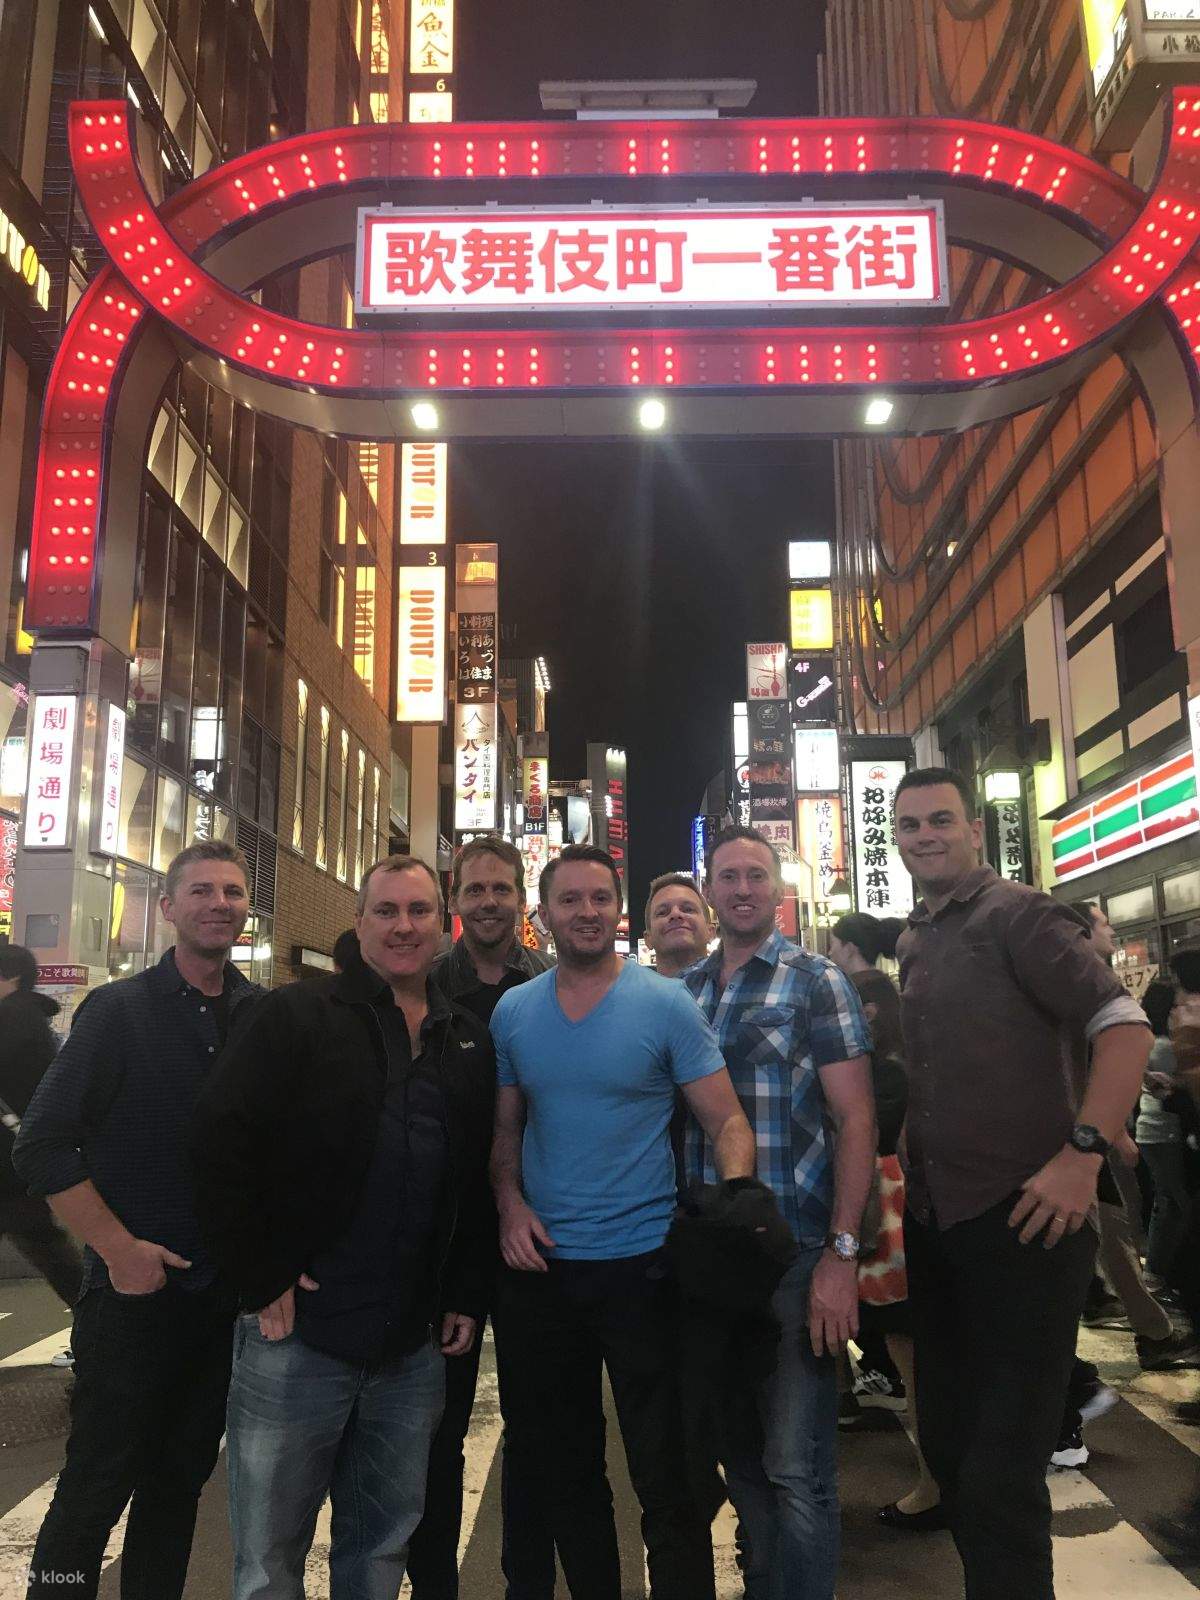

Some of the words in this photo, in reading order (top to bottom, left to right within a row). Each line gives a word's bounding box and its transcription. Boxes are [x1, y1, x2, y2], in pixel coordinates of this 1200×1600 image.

[436, 78, 446, 92] 6
[385, 225, 917, 295] 歌舞伎町一番街
[428, 551, 437, 566] 3
[408, 589, 435, 693] DOUTOR
[748, 643, 784, 656] SHISHA
[794, 662, 810, 673] 4F
[463, 686, 490, 698] 3F
[37, 707, 67, 834] 劇場通り
[461, 738, 480, 803] バンタイ
[525, 822, 545, 831] B1F
[862, 786, 890, 908] お好み焼本陣
